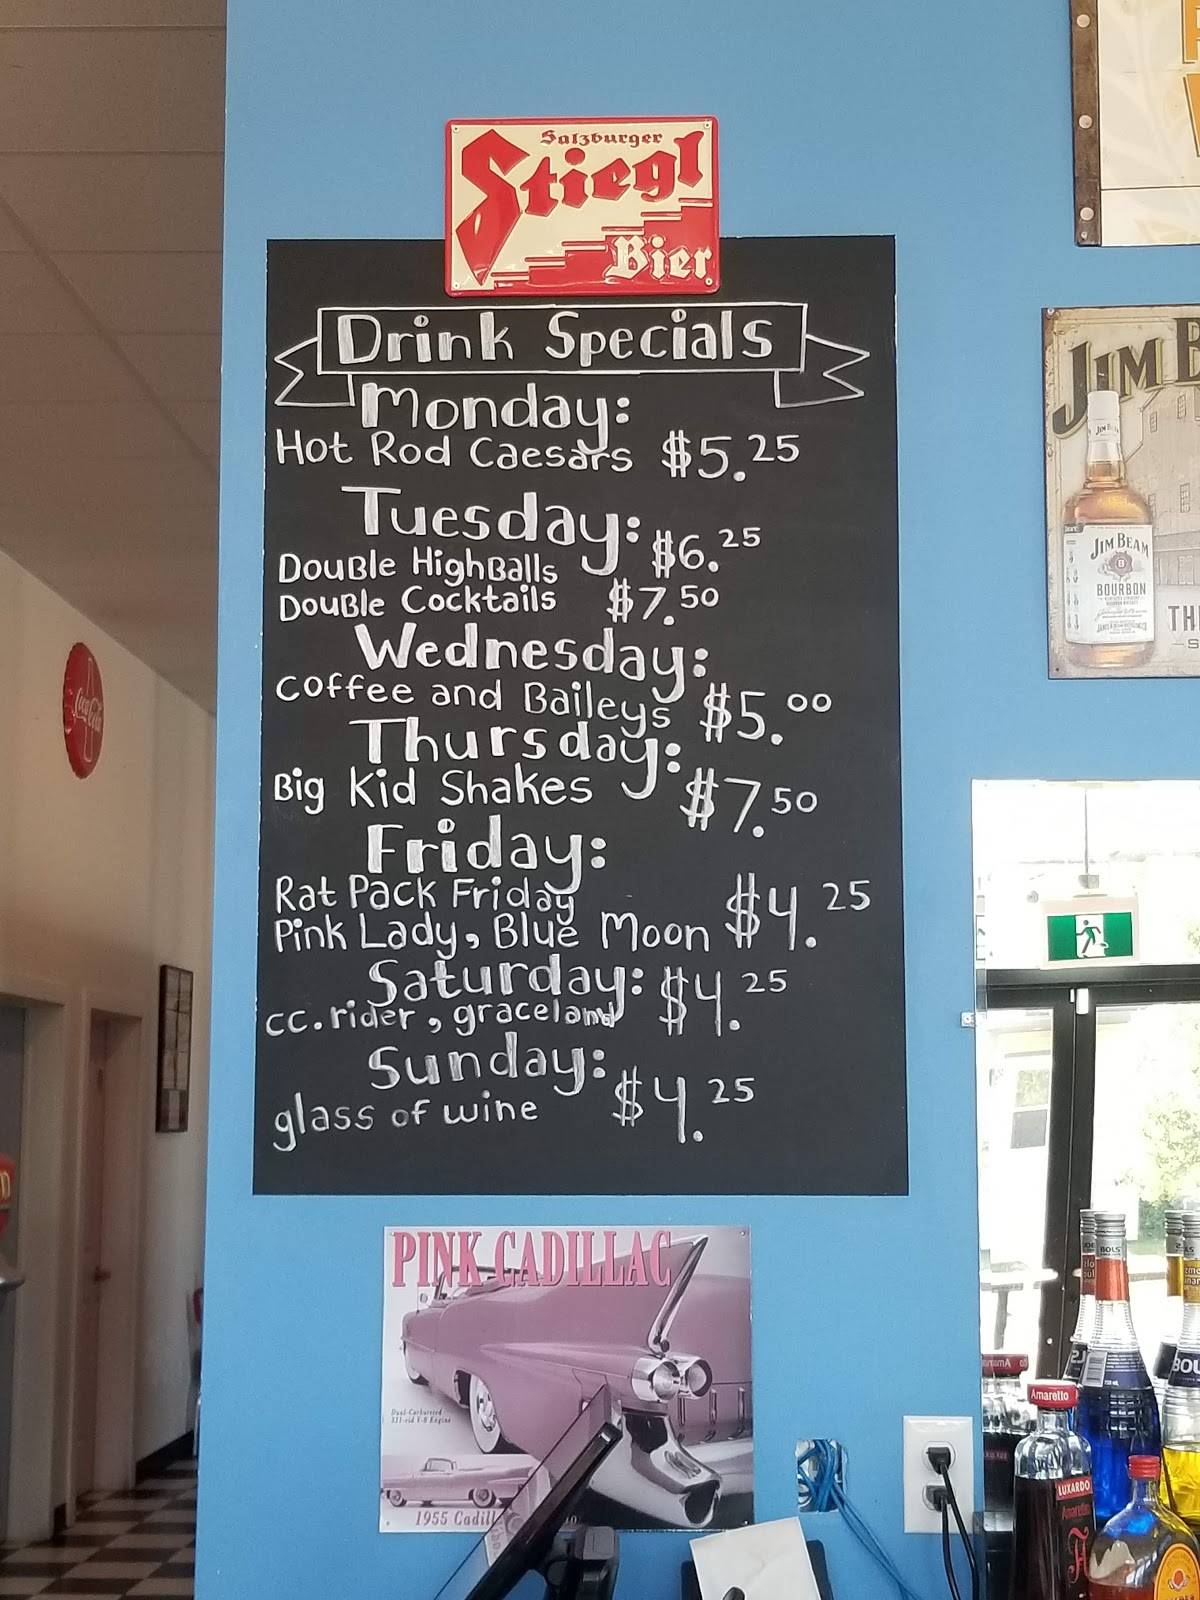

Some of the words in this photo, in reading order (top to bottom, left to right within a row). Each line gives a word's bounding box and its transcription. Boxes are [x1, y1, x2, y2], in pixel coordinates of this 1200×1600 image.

[540, 130, 664, 148] Salzburger
[455, 128, 705, 286] Stiegl
[605, 235, 712, 281] Bier
[337, 311, 514, 365] Drink
[545, 309, 774, 368] Specials
[361, 383, 631, 455] Monday:
[276, 429, 352, 466] Hot
[371, 430, 452, 468] Rod
[470, 437, 634, 473] Caesars
[341, 486, 641, 576] Tuesday:
[1090, 537, 1115, 560] JIM
[1117, 532, 1149, 559] BEAM
[401, 584, 557, 616] Cocktails
[1096, 582, 1147, 597] BOURBON
[354, 622, 710, 704] Wednesday:
[431, 680, 502, 712] and
[524, 681, 672, 739] Baileys
[349, 716, 681, 799] Thursday:
[274, 768, 326, 815] Big
[350, 766, 416, 808] Kid
[440, 763, 593, 806] Shakes
[367, 814, 607, 894] Friday:
[276, 876, 337, 912] Rat
[349, 878, 437, 911] Pack
[453, 877, 576, 926] Friday
[274, 916, 348, 954] Pink
[360, 915, 480, 960] Lady,
[494, 913, 580, 949] Blue
[601, 912, 711, 952] Moon
[369, 954, 645, 1023] Saturday:
[453, 999, 618, 1036] graceland
[369, 1031, 607, 1096] Sunday:
[273, 1092, 374, 1152] glass
[392, 1100, 430, 1128] of
[444, 1090, 539, 1125] wine
[391, 1231, 483, 1289] PINK
[494, 1230, 672, 1289] CADILLAC
[1031, 1390, 1069, 1402] Amaretto
[1058, 1481, 1091, 1497] LUXARDO
[415, 1511, 448, 1526] 1955
